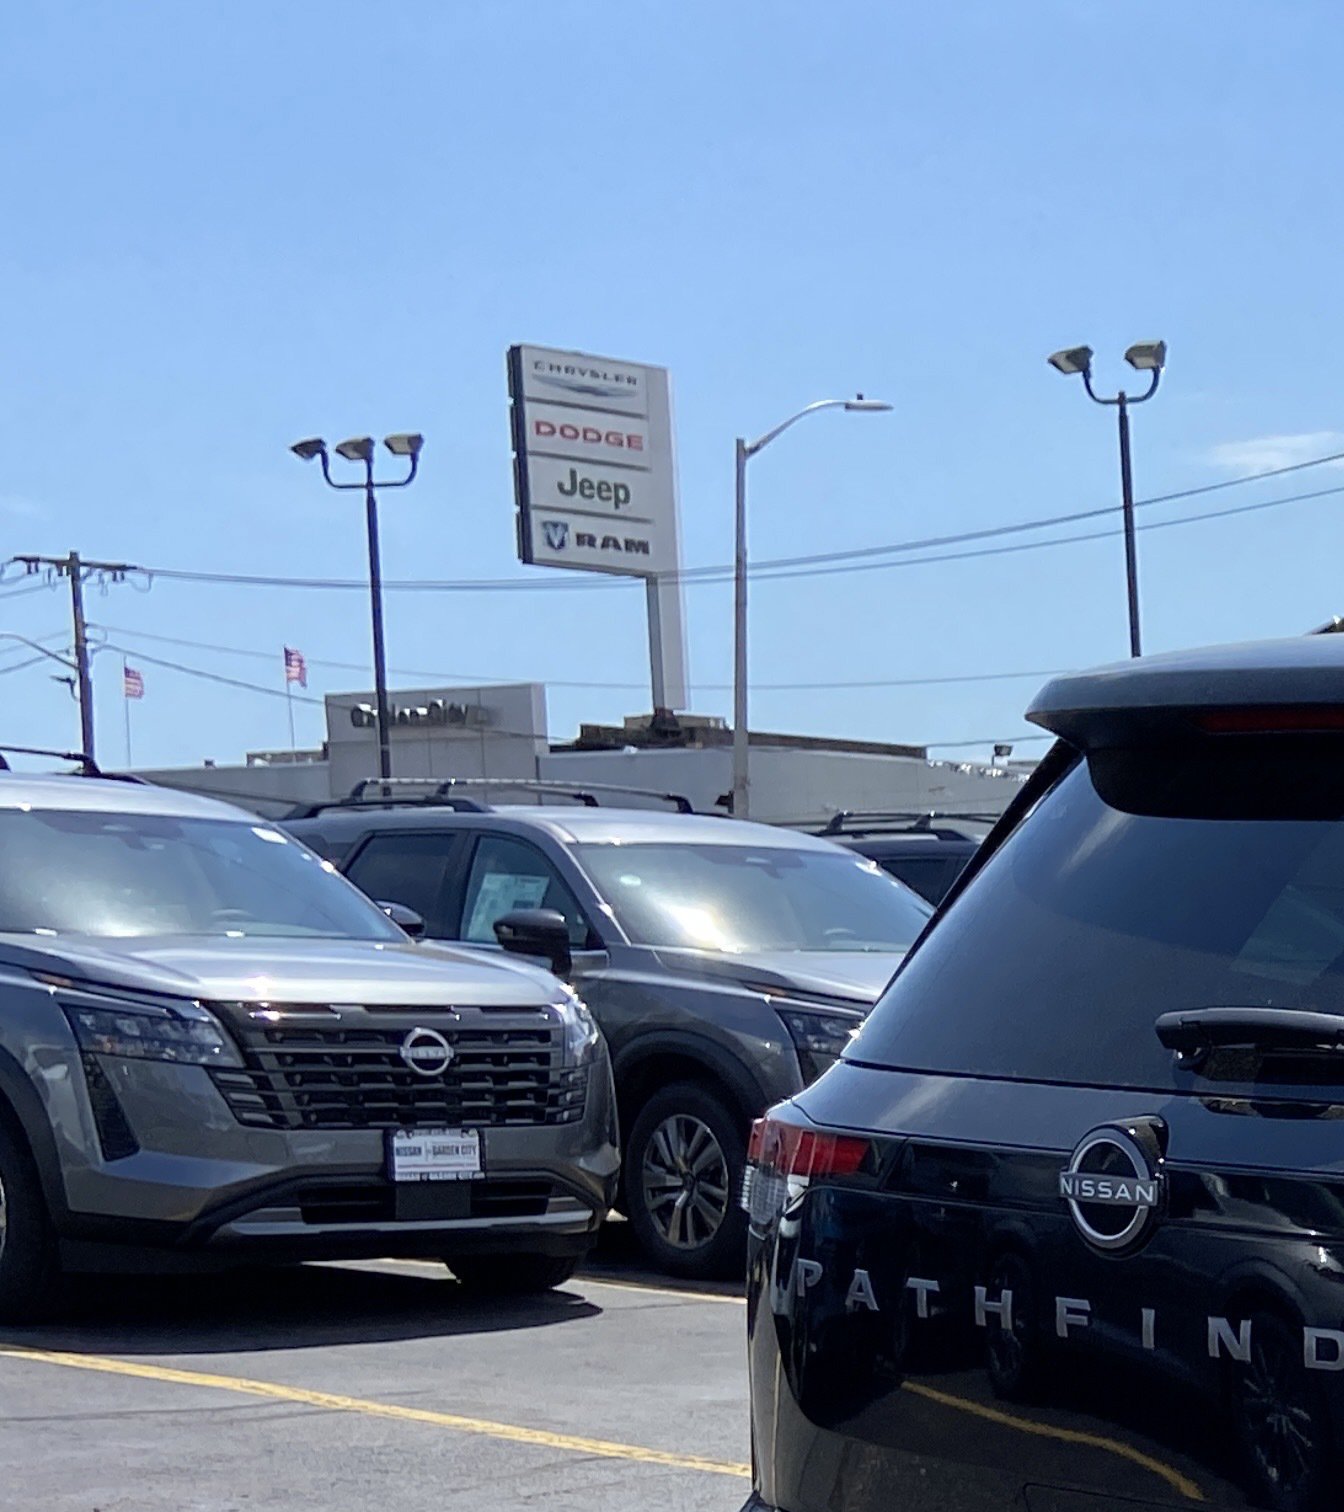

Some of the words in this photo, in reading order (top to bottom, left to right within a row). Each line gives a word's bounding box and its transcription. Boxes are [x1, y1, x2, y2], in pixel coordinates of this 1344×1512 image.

[534, 361, 637, 386] CHRYSLER
[535, 420, 644, 451] DODGE
[557, 468, 631, 510] Jeep
[575, 532, 650, 555] RAM
[1061, 1177, 1154, 1202] NISSAN
